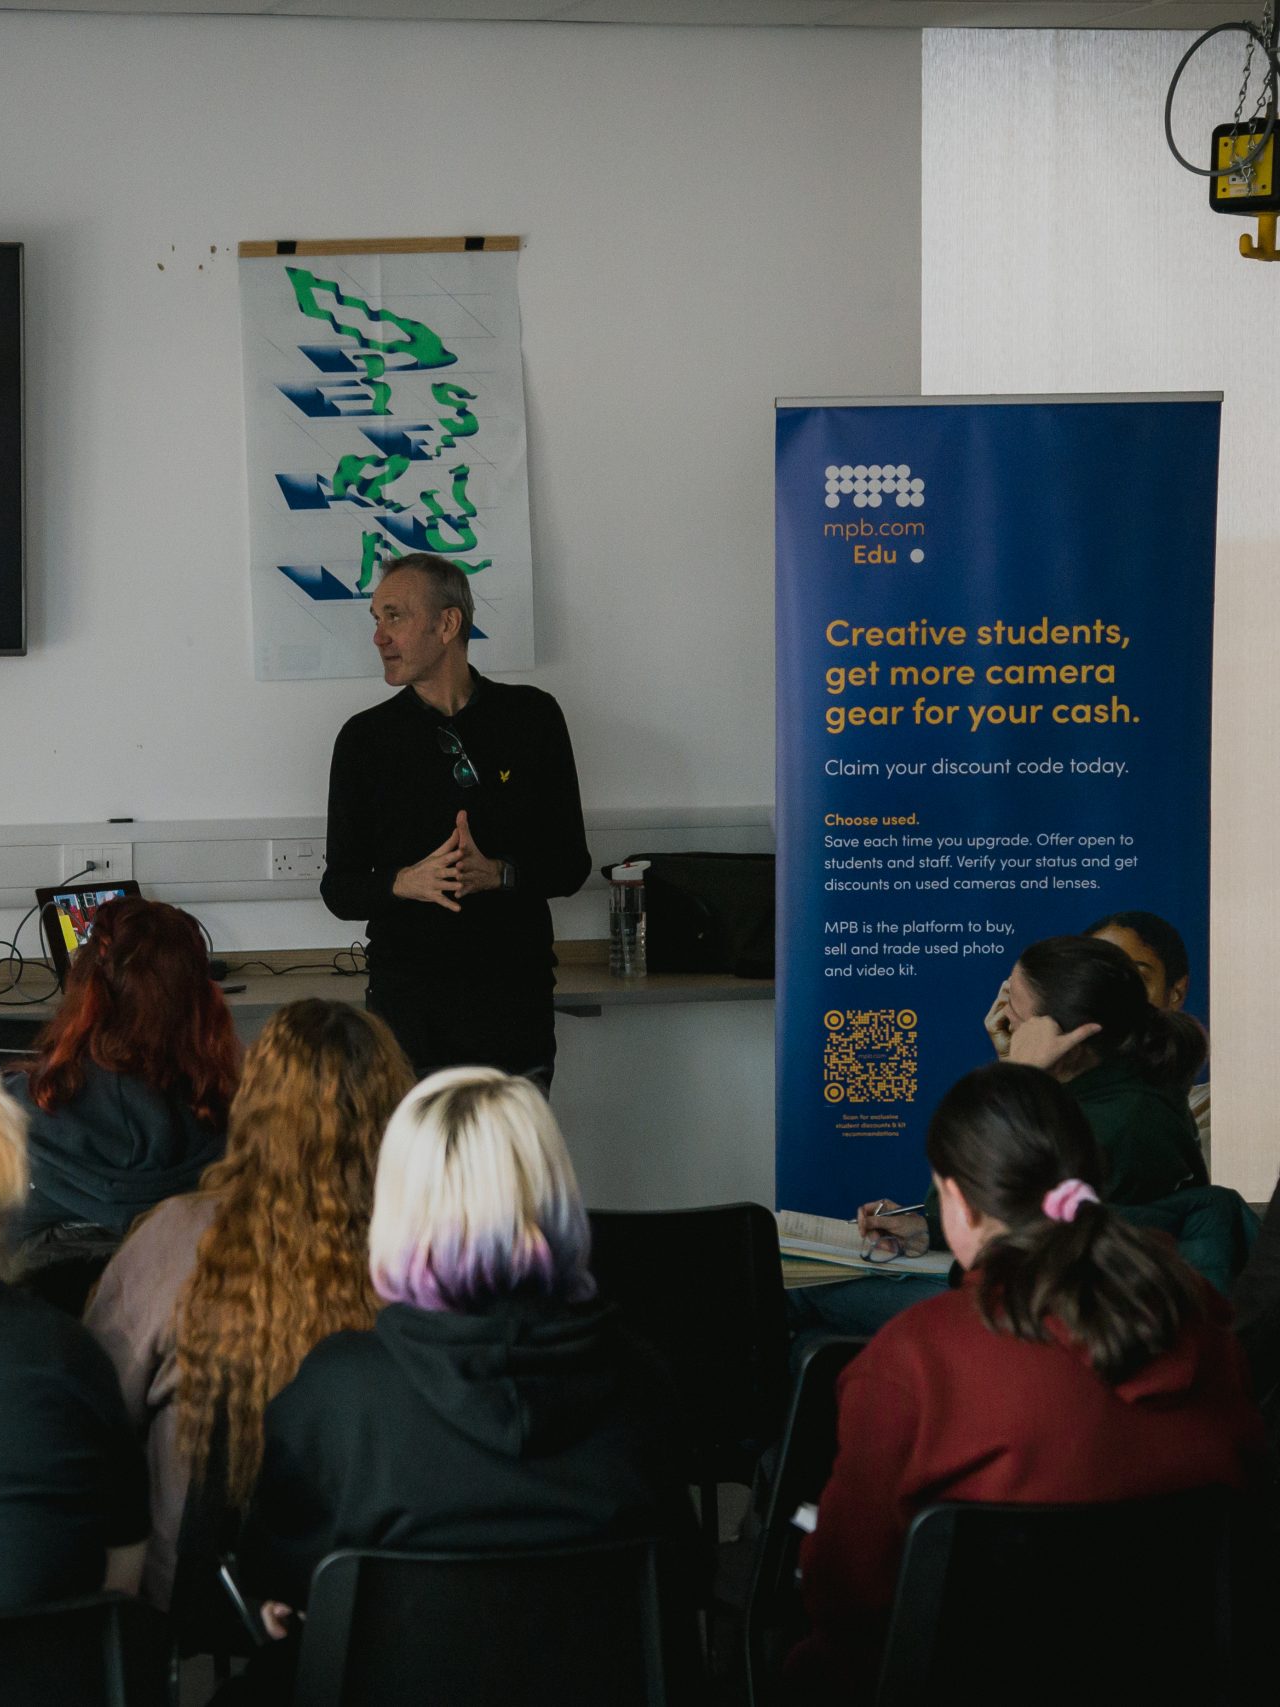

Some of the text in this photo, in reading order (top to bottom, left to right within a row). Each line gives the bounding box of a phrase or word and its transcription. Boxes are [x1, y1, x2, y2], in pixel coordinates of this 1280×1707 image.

[824, 518, 925, 541] mpb.com
[853, 545, 897, 564] Edu
[825, 617, 1130, 649] Creative students,
[825, 661, 1115, 694] get more camera
[825, 696, 1140, 734] gear for your cash.
[825, 757, 1129, 779] Claim your discount code today.
[824, 812, 920, 826] Choose used.
[824, 832, 1134, 850] Save each time you upgrade. Offer open to
[824, 854, 1138, 871] students and staff. Verify your status and get
[824, 876, 1100, 891] discounts on used cameras and lenses.
[824, 919, 1015, 936] MPB is the platform to buy,
[824, 941, 1005, 957] sell and trade used photo
[824, 963, 918, 977] and video kit.
